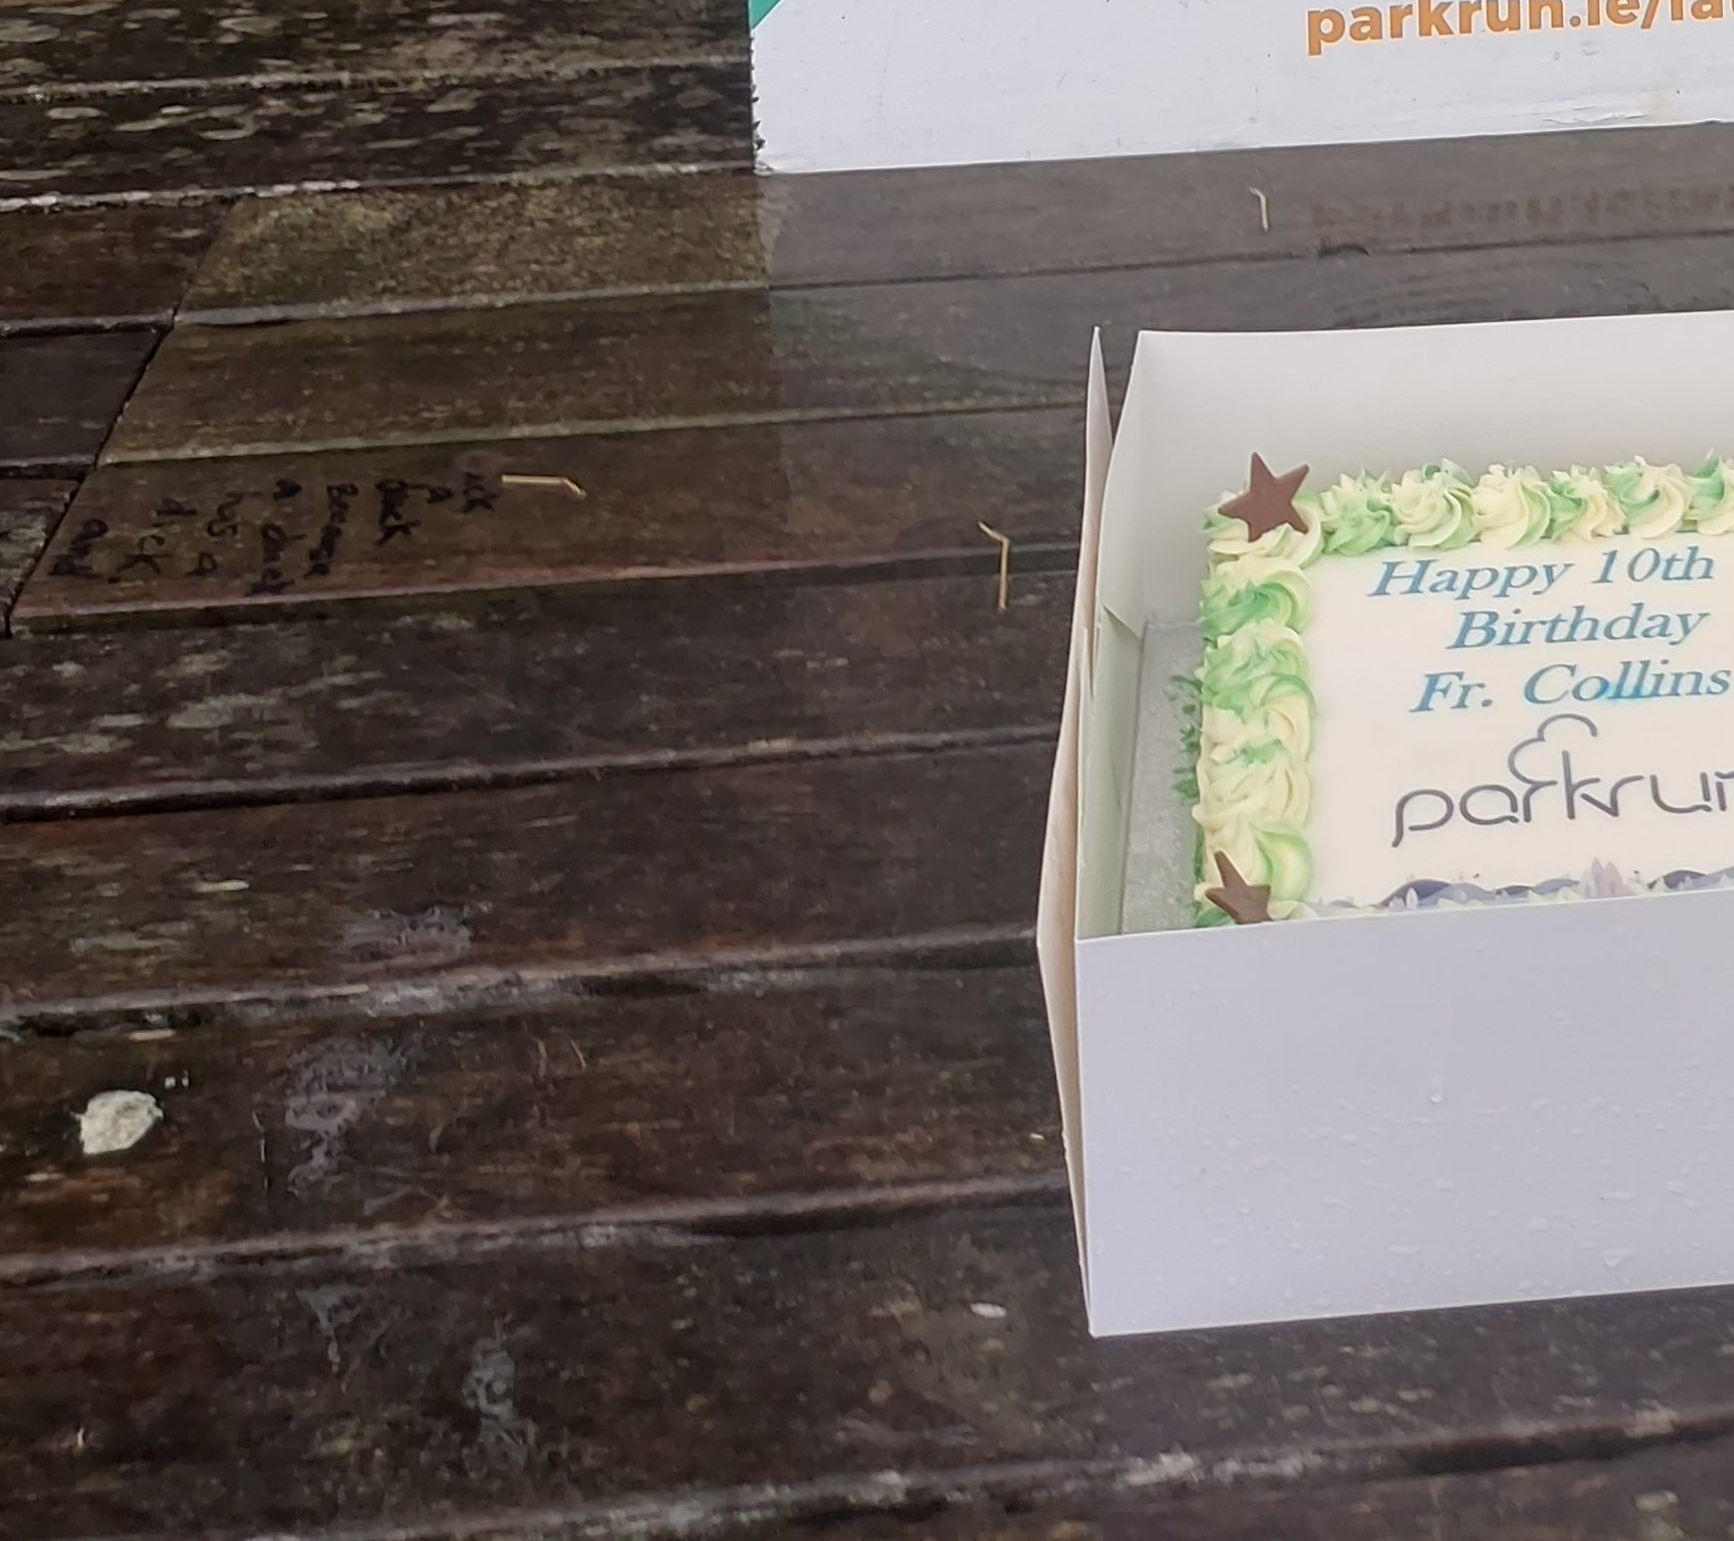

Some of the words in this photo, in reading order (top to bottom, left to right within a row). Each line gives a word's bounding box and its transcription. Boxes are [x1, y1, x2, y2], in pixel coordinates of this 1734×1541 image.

[1367, 556, 1574, 601] Happy
[1592, 545, 1716, 585] 10th
[1445, 602, 1712, 650] Birthday
[1408, 669, 1494, 714] Fr.
[1523, 660, 1733, 706] Collins
